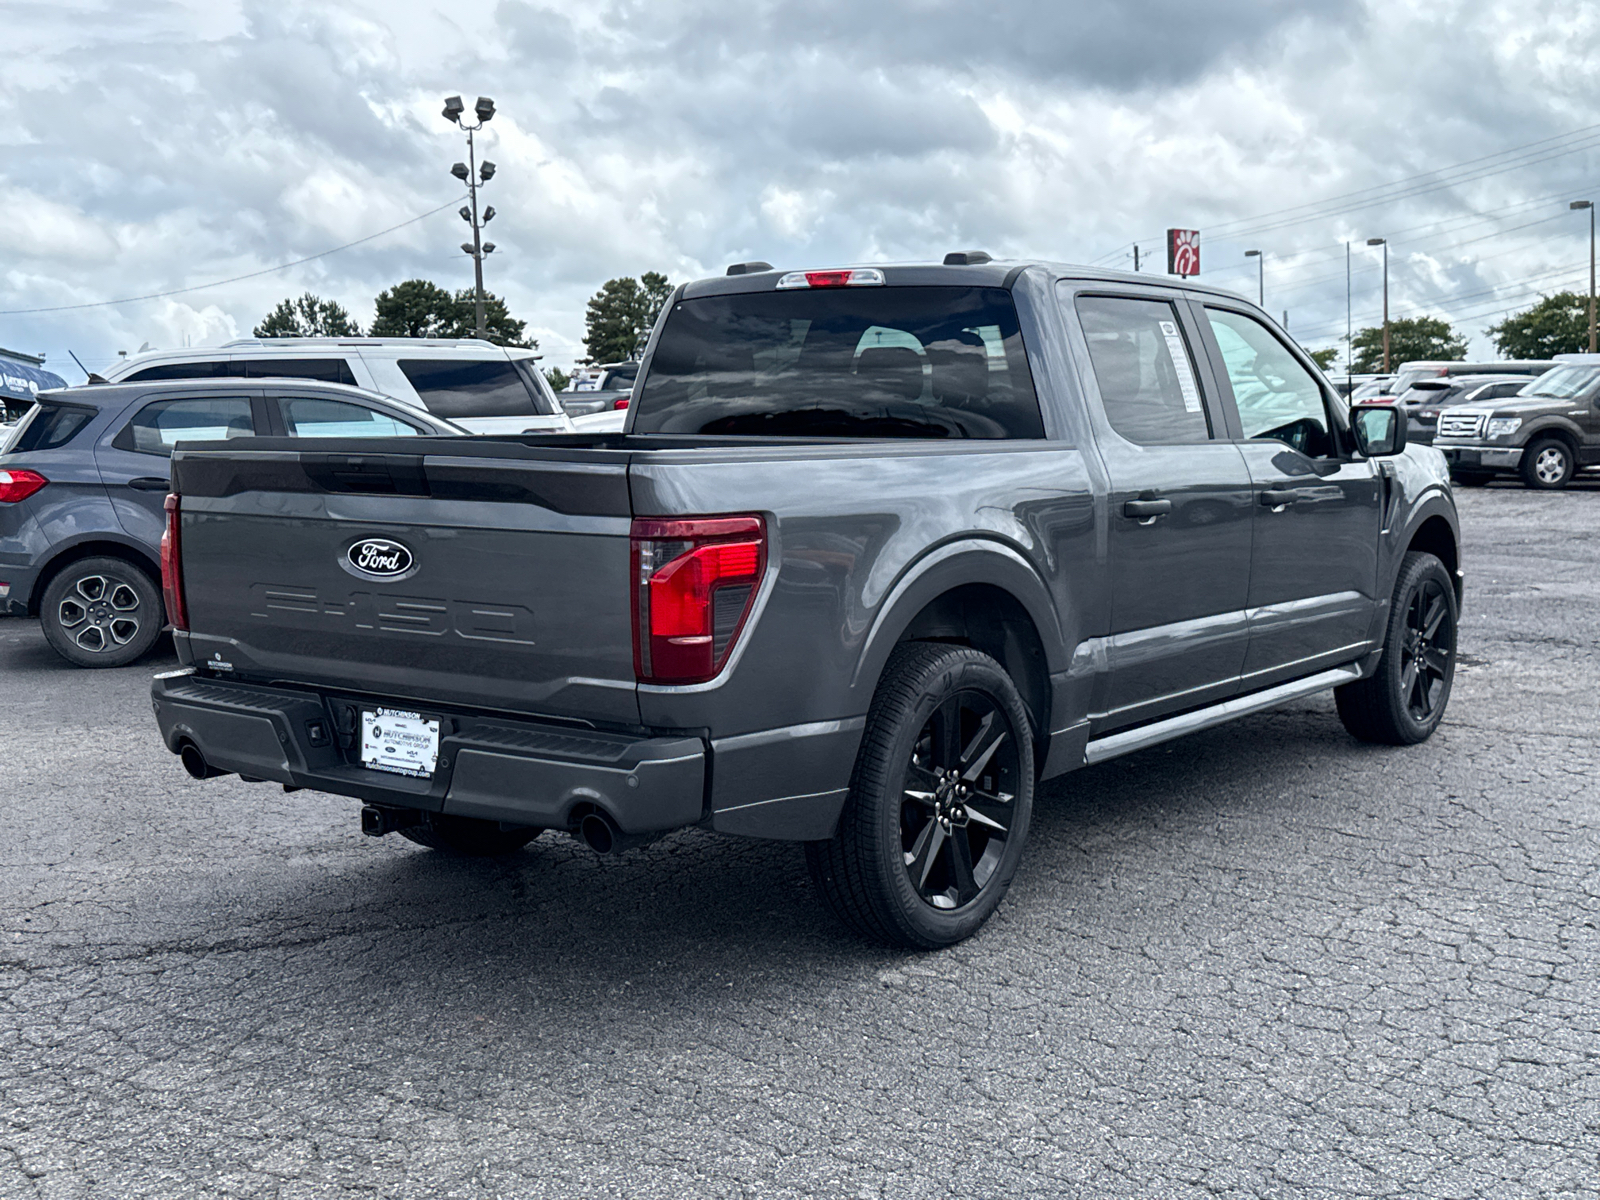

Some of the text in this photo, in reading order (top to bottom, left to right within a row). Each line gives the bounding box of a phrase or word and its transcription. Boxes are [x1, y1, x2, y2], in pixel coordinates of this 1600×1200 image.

[358, 543, 400, 569] Ford
[250, 581, 536, 646] F-150
[383, 708, 420, 720] HUTCHINSON
